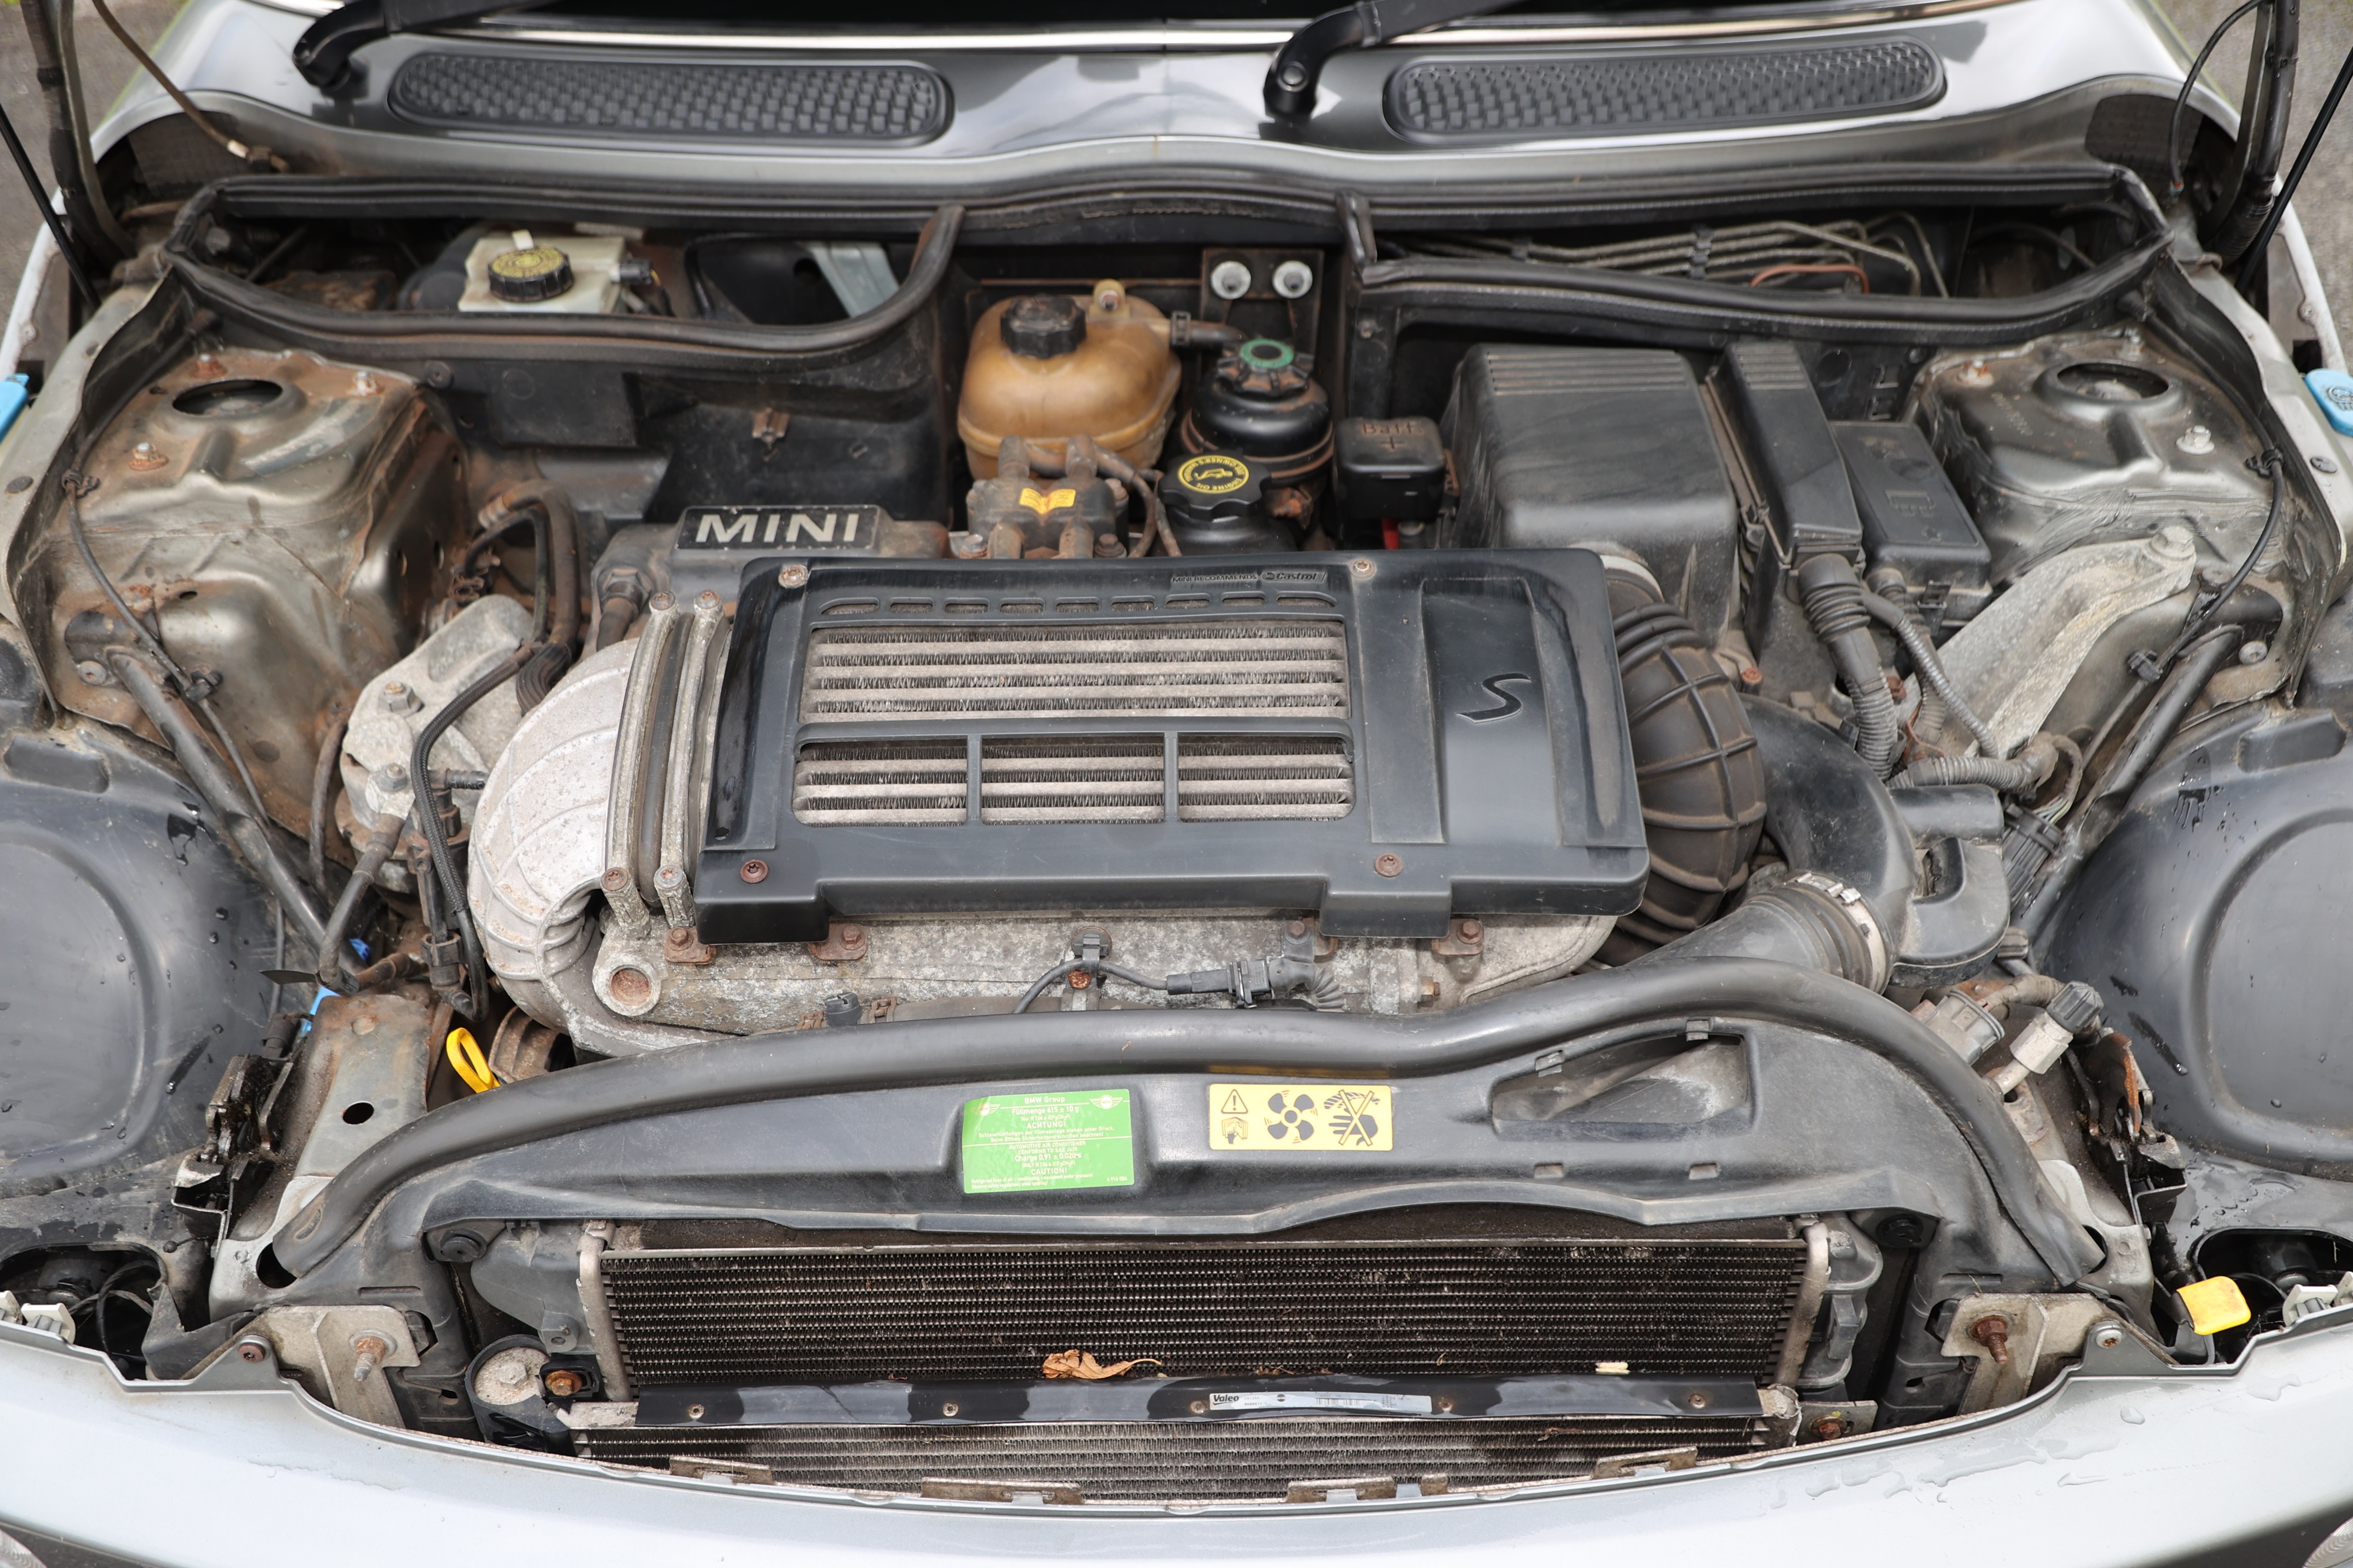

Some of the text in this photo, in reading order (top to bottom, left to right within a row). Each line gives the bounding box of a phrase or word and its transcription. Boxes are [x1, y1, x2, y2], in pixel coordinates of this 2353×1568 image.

[1212, 478, 1242, 491] ENGINE
[695, 513, 859, 543] MINI
[1275, 572, 1317, 581] Castrol
